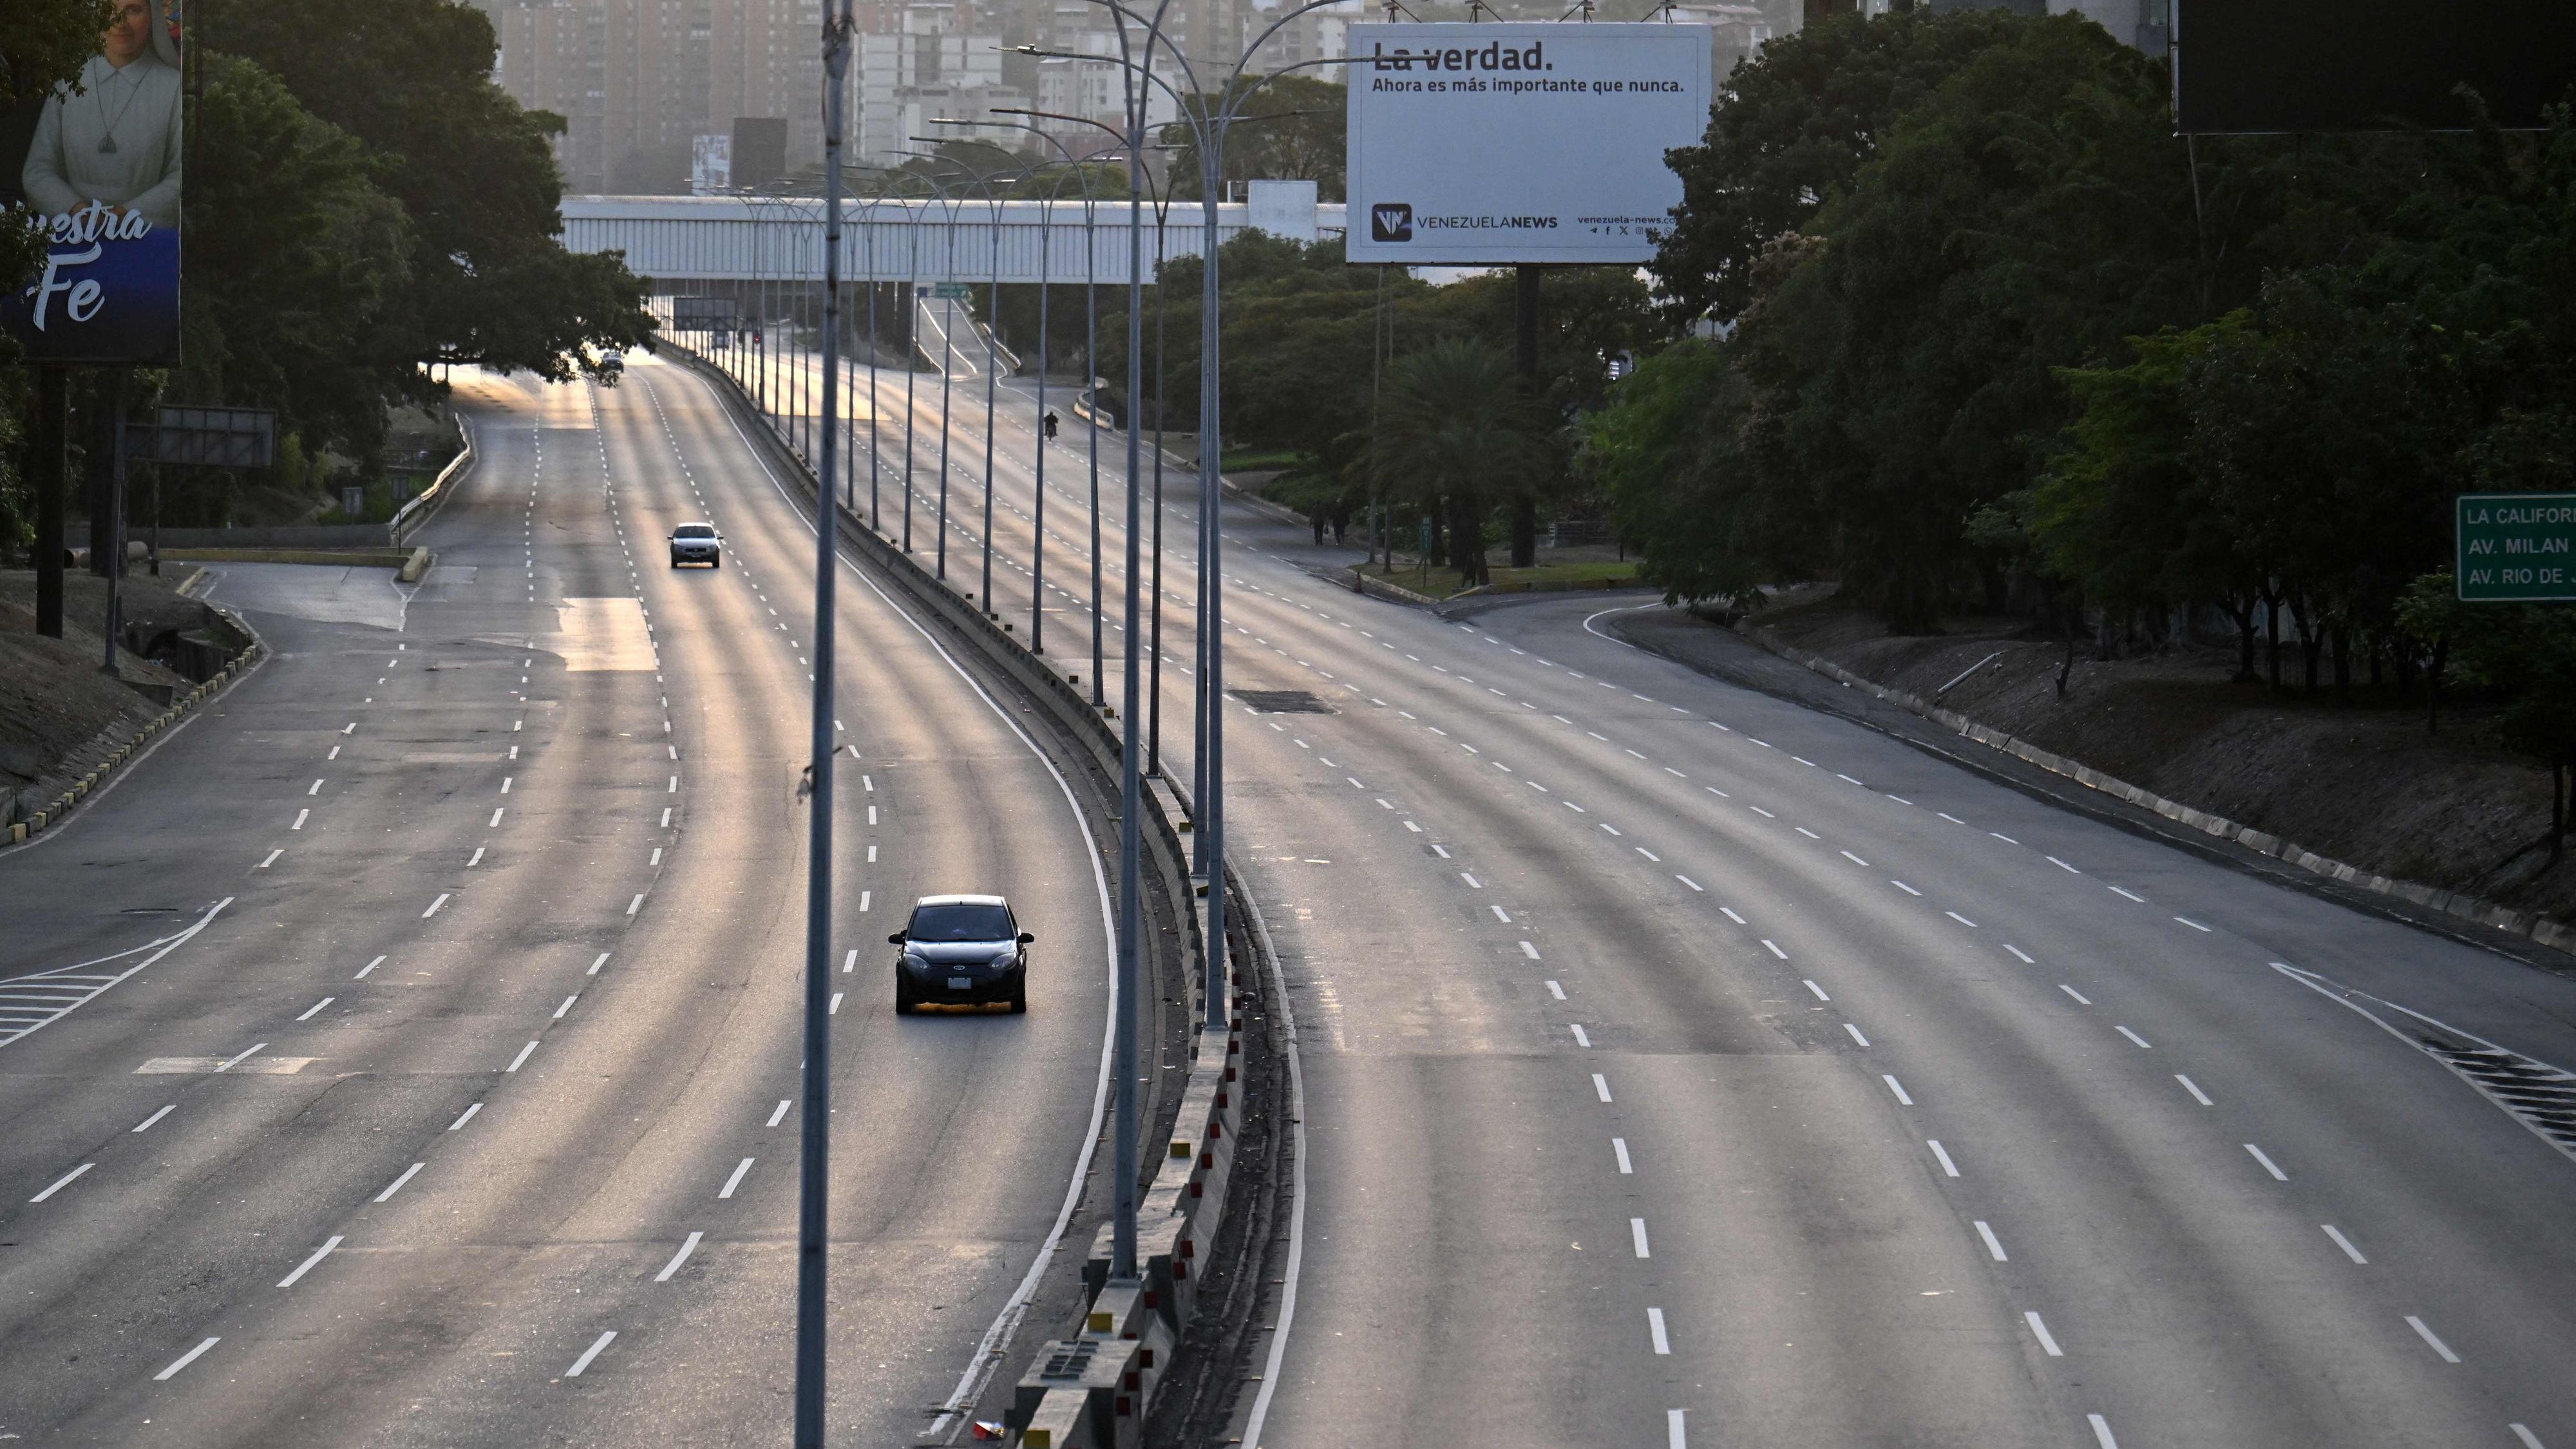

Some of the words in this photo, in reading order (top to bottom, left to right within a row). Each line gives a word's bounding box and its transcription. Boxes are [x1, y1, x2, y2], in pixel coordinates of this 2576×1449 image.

[1374, 42, 1412, 71] La
[1423, 41, 1553, 71] verdad.
[1372, 78, 1422, 92] Ahora
[1427, 81, 1446, 92] es
[1452, 77, 1486, 92] más
[1493, 77, 1587, 95] importante
[1593, 81, 1623, 95] que
[1629, 81, 1684, 92] nunca.
[1578, 215, 1675, 224] venezuela-news.co
[26, 241, 105, 332] Fe
[2467, 509, 2489, 524] LA
[2496, 507, 2576, 524] CALIFOR
[2468, 539, 2497, 554] AV.
[2506, 538, 2568, 554] MILAN
[2468, 569, 2495, 584] AV.
[2503, 568, 2533, 584] RIO
[2539, 568, 2563, 584] DE
